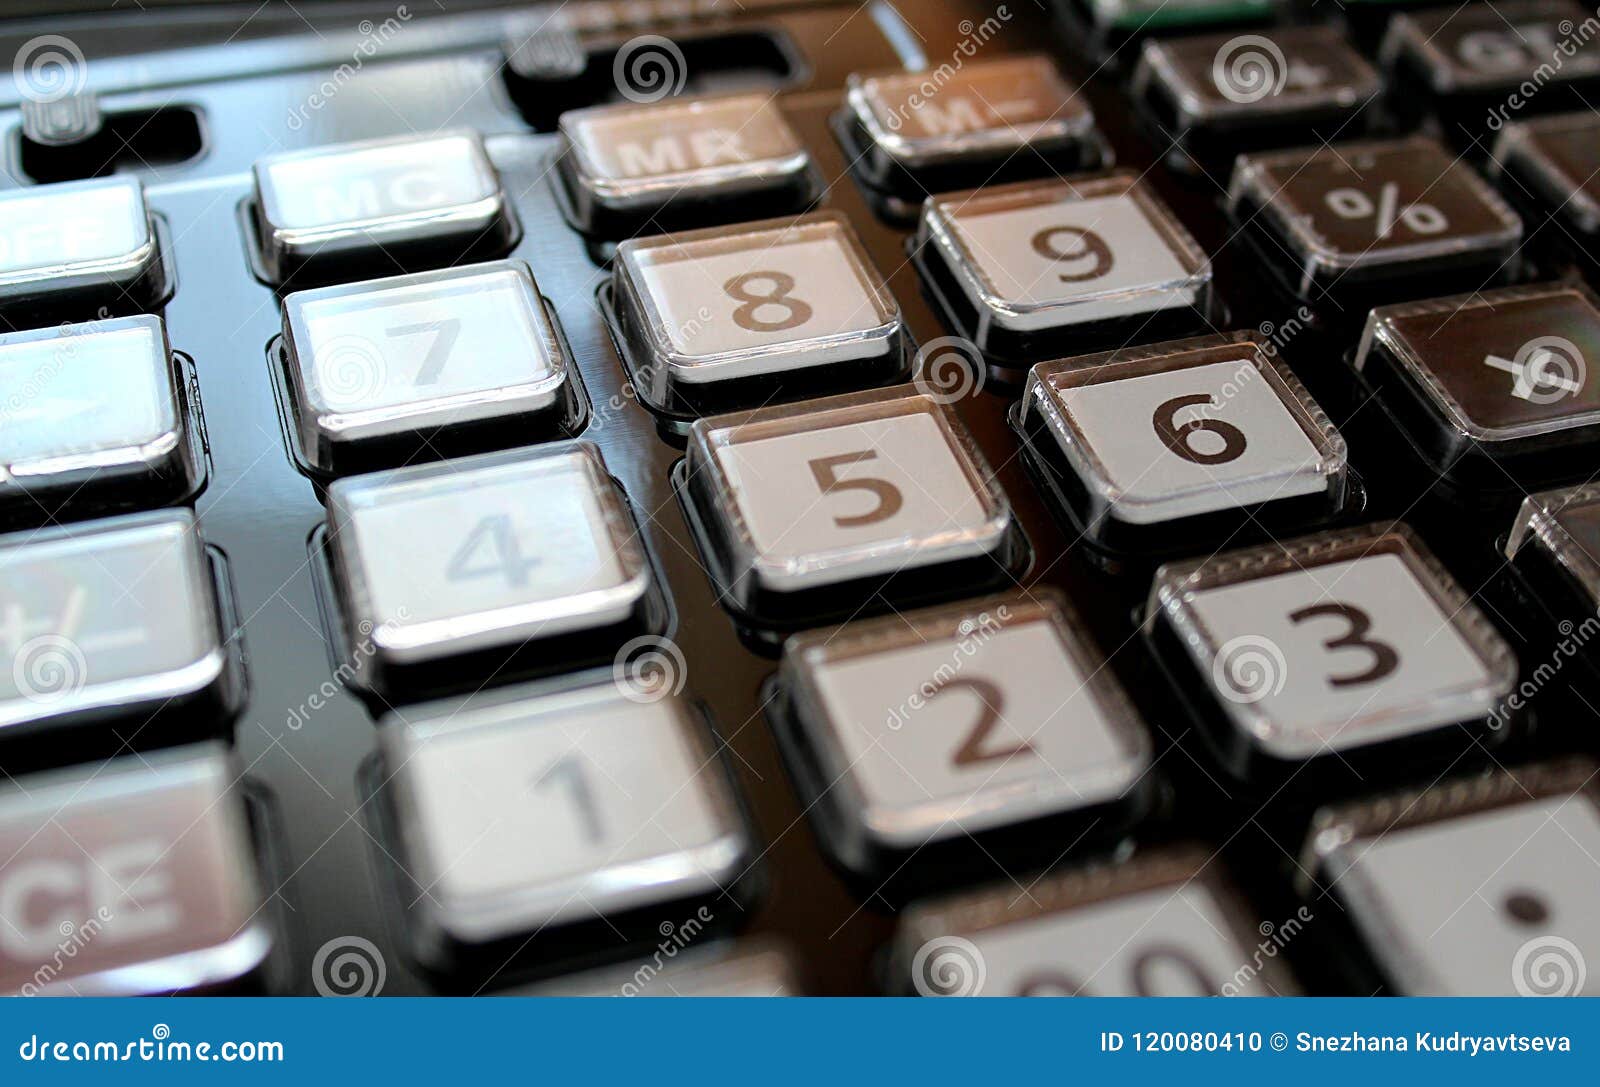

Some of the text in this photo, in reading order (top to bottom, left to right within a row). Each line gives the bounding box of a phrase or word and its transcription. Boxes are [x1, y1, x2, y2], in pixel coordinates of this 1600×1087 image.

[615, 131, 750, 177] MR
[315, 167, 448, 217] MC
[1325, 181, 1449, 240] %
[0, 219, 106, 262] FF
[1031, 225, 1115, 283] 9
[723, 269, 813, 333] 8
[385, 317, 463, 387] 7
[1152, 393, 1247, 466] 6
[808, 449, 904, 528] 5
[445, 511, 543, 590] 4
[1288, 603, 1400, 686] 3
[924, 671, 1042, 769] 2
[531, 747, 607, 846] 1
[0, 836, 181, 962] CE
